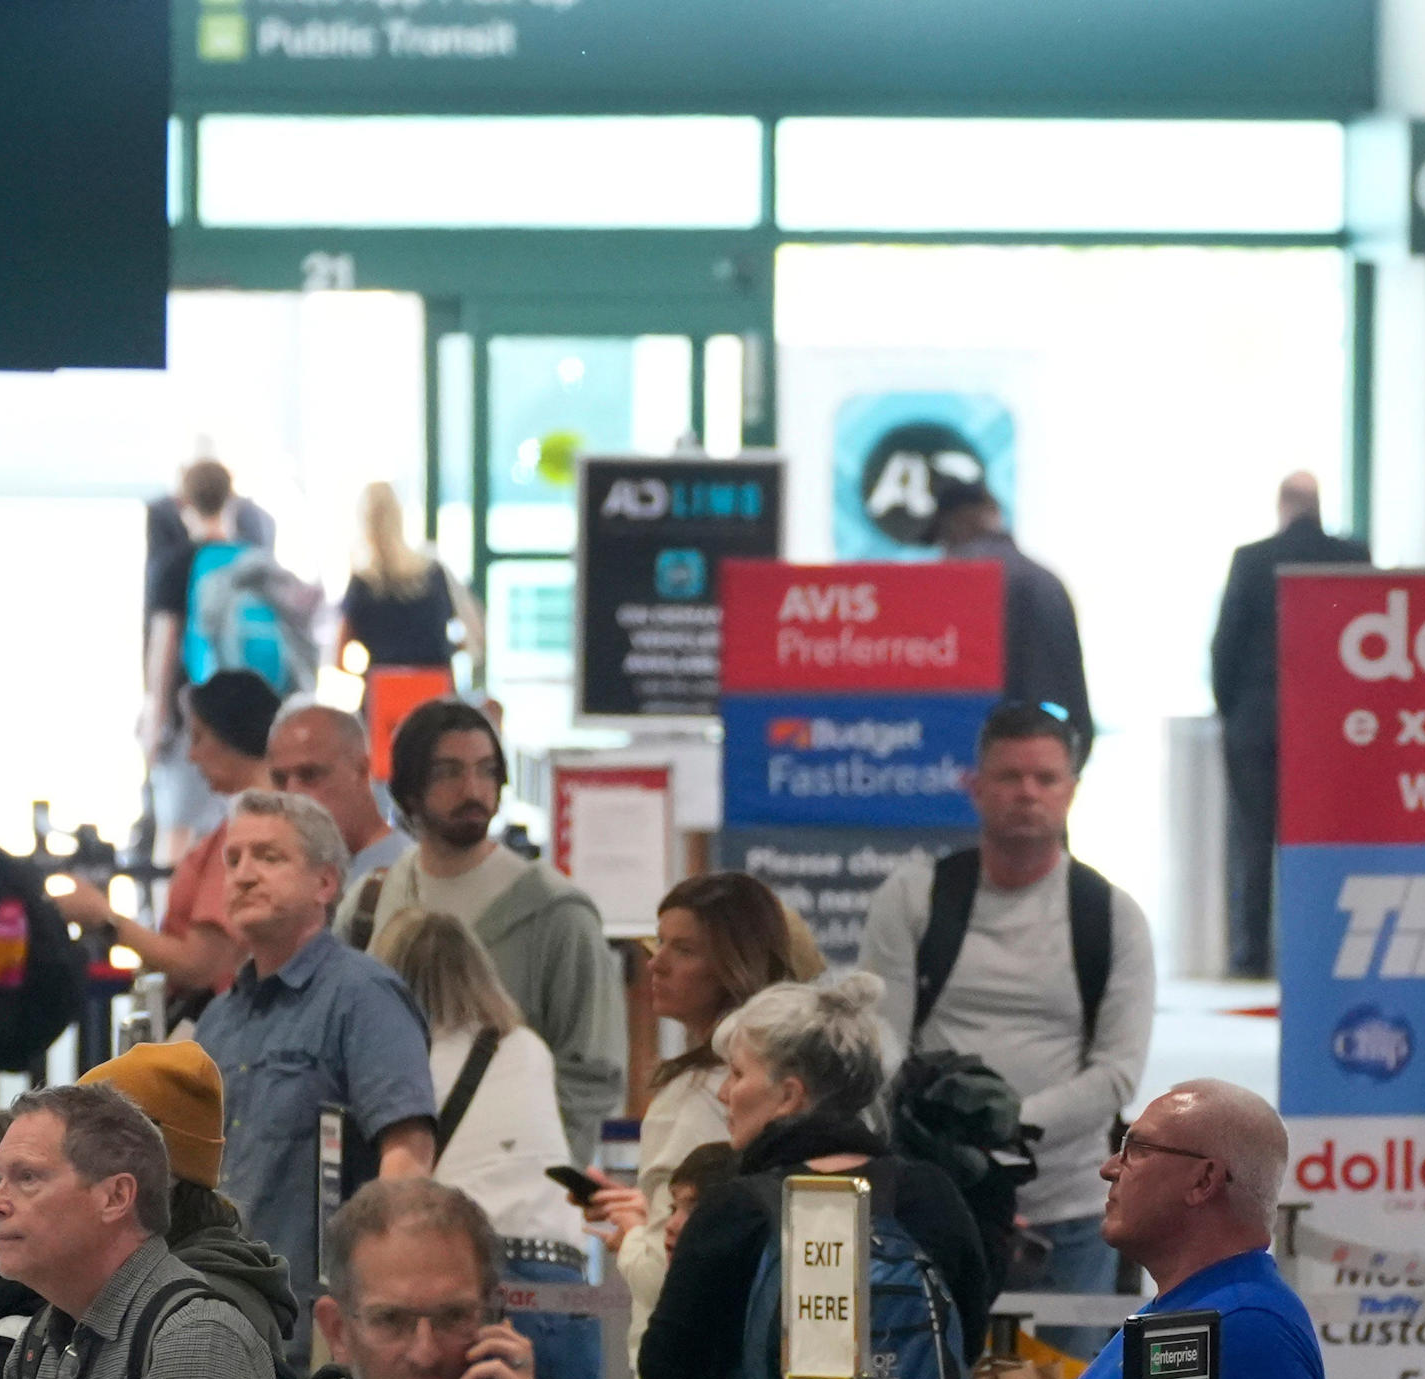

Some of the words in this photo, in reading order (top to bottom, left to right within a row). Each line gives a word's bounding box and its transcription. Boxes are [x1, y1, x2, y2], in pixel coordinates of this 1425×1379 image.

[257, 14, 375, 58] Public
[384, 16, 517, 58] Transit
[673, 479, 763, 520] LIMO
[778, 583, 881, 622] AVIS
[777, 626, 958, 667] Preferred
[811, 717, 922, 758] Budget
[804, 1241, 844, 1267] EXIT
[798, 1295, 849, 1321] HERE
[1152, 1346, 1198, 1368] enterprise
